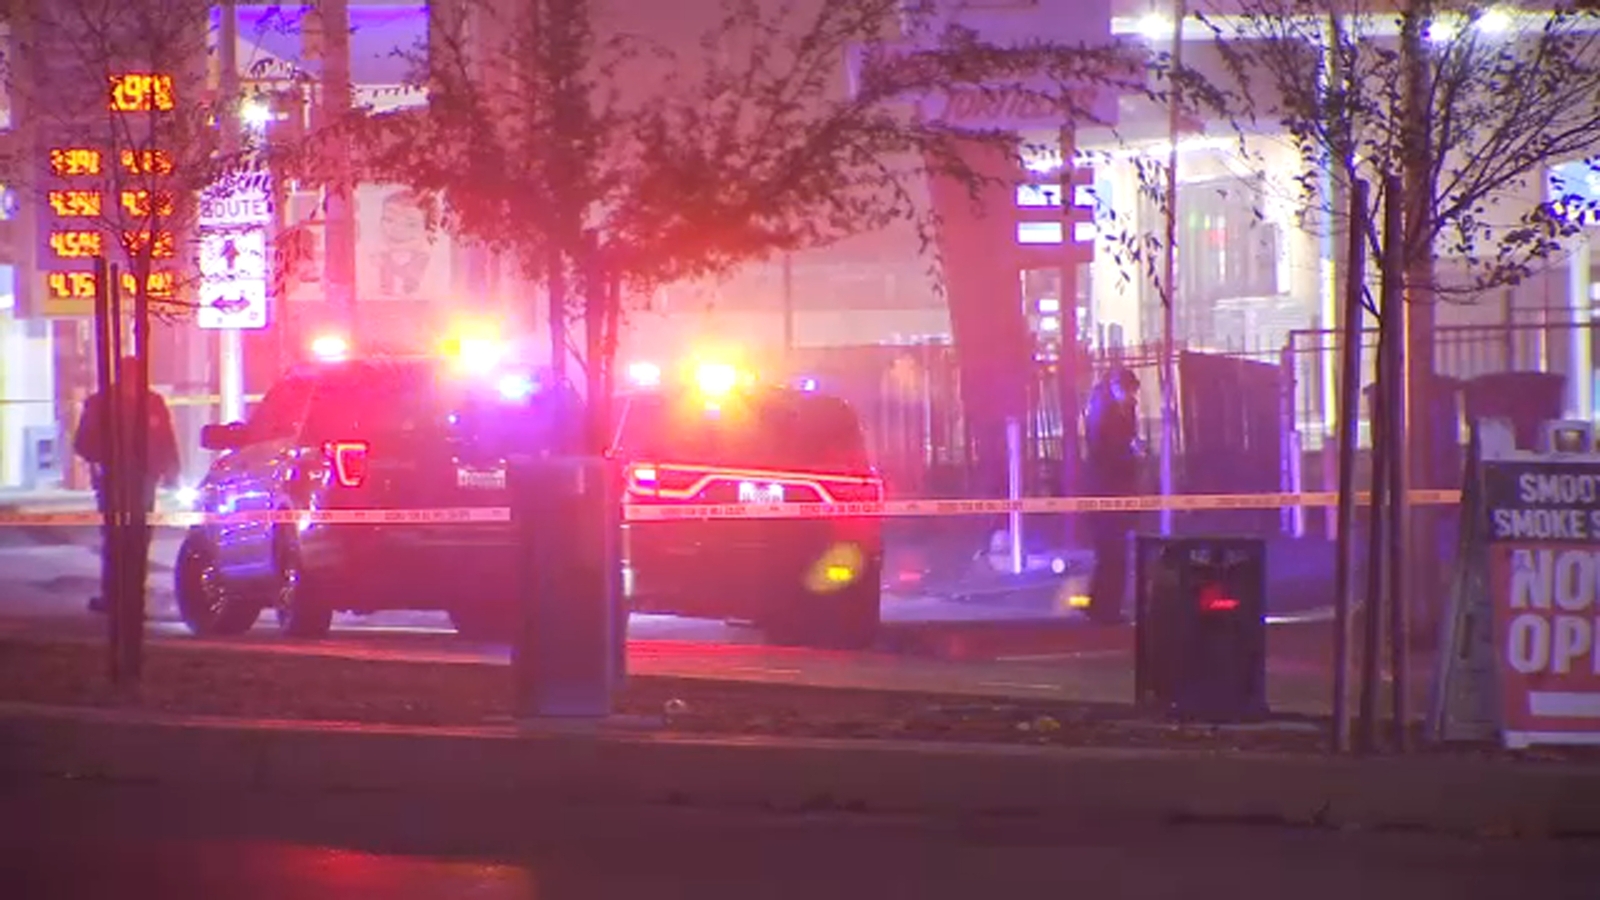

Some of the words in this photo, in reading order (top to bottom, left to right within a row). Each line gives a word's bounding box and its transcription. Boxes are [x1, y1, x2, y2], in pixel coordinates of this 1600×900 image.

[202, 201, 263, 218] ROUTE
[1494, 509, 1587, 538] SMOKE
[1510, 549, 1600, 611] NO
[1508, 614, 1600, 674] OP
